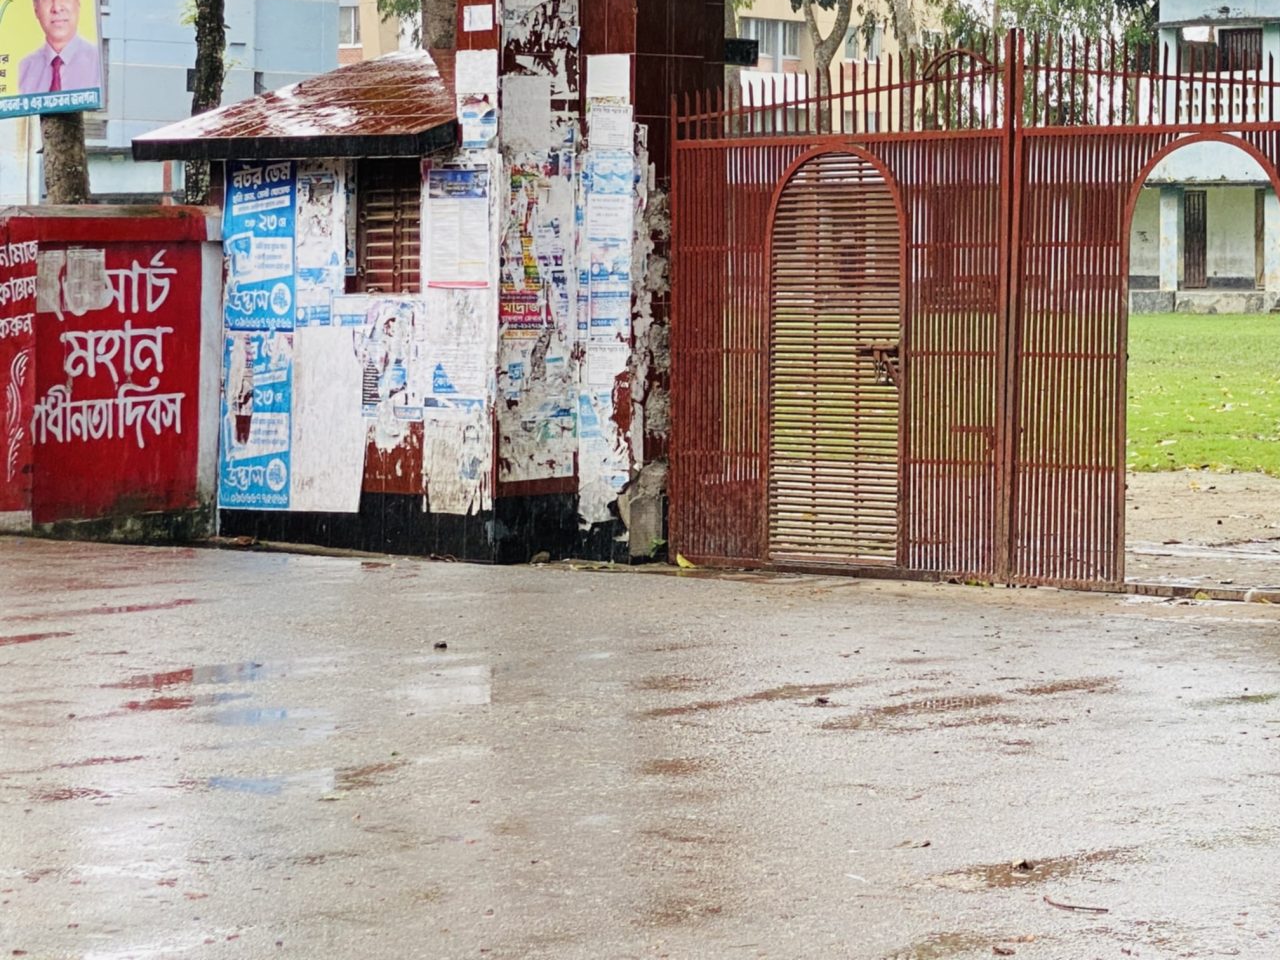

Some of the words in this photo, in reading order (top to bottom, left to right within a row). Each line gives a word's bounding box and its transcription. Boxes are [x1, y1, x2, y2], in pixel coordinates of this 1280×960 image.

[232, 164, 263, 189] নটর
[265, 161, 291, 183] ডেম
[259, 213, 277, 231] ২৩
[103, 249, 178, 314] মার্চ
[60, 320, 174, 383] মহান
[31, 384, 114, 446] াধীনতা
[114, 376, 186, 449] দিবস
[254, 388, 274, 406] ২৩
